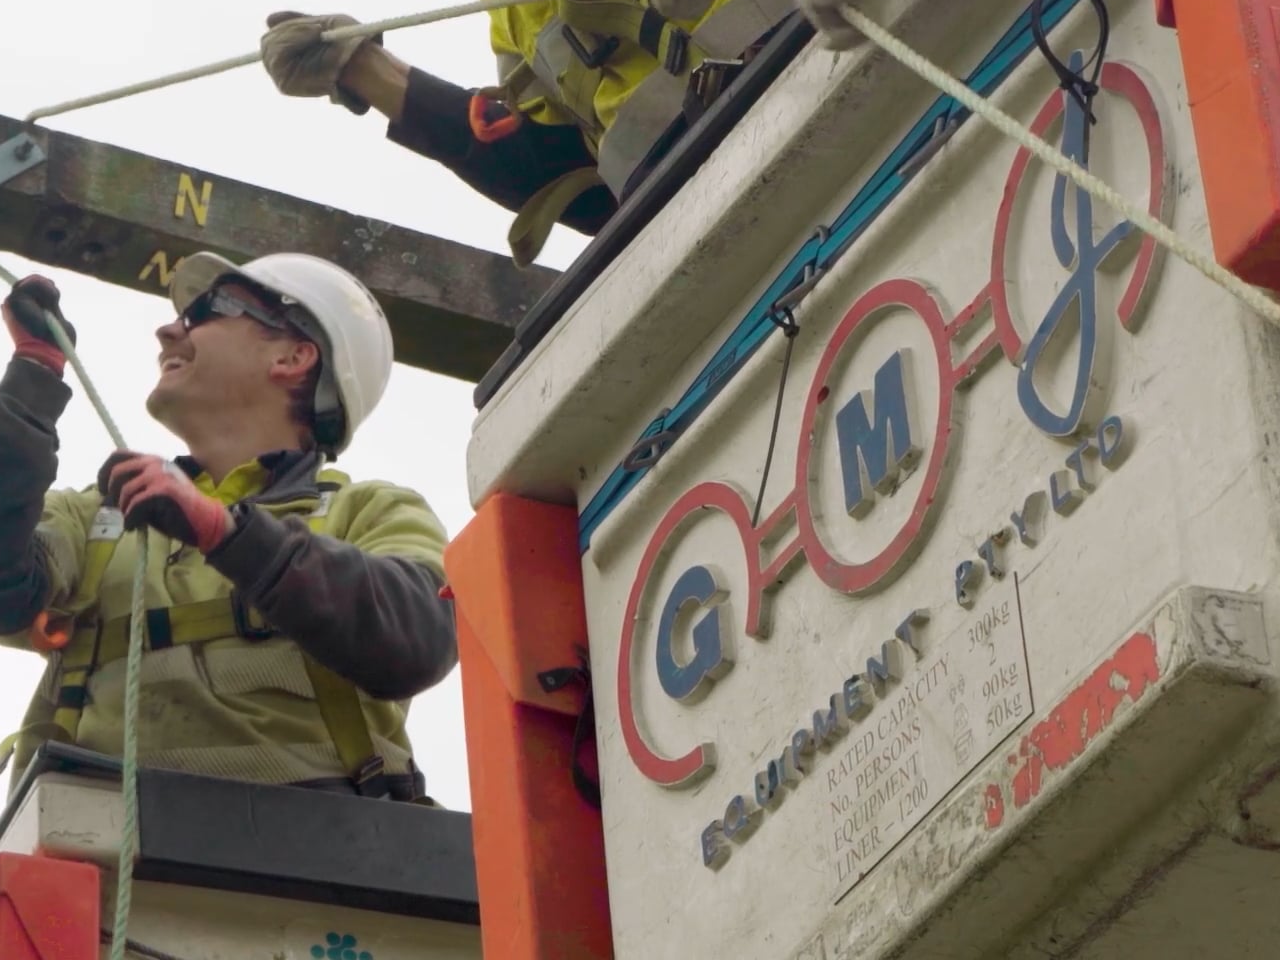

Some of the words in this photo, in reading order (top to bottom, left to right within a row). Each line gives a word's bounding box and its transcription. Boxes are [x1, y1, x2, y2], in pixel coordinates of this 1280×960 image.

[175, 172, 213, 227] N
[701, 608, 928, 872] EQUIPMENT
[1050, 416, 1132, 518] LTD
[826, 731, 875, 793] RATED
[876, 652, 951, 749] CAPACITY
[968, 600, 1011, 653] 300kg
[855, 717, 922, 798] PERSONS
[987, 642, 998, 667] 2
[833, 751, 921, 853] EQUIPMENT
[981, 661, 1019, 703] 90kg
[835, 825, 880, 884] LINER
[898, 779, 930, 827] 1200
[986, 690, 1023, 737] 50kg
